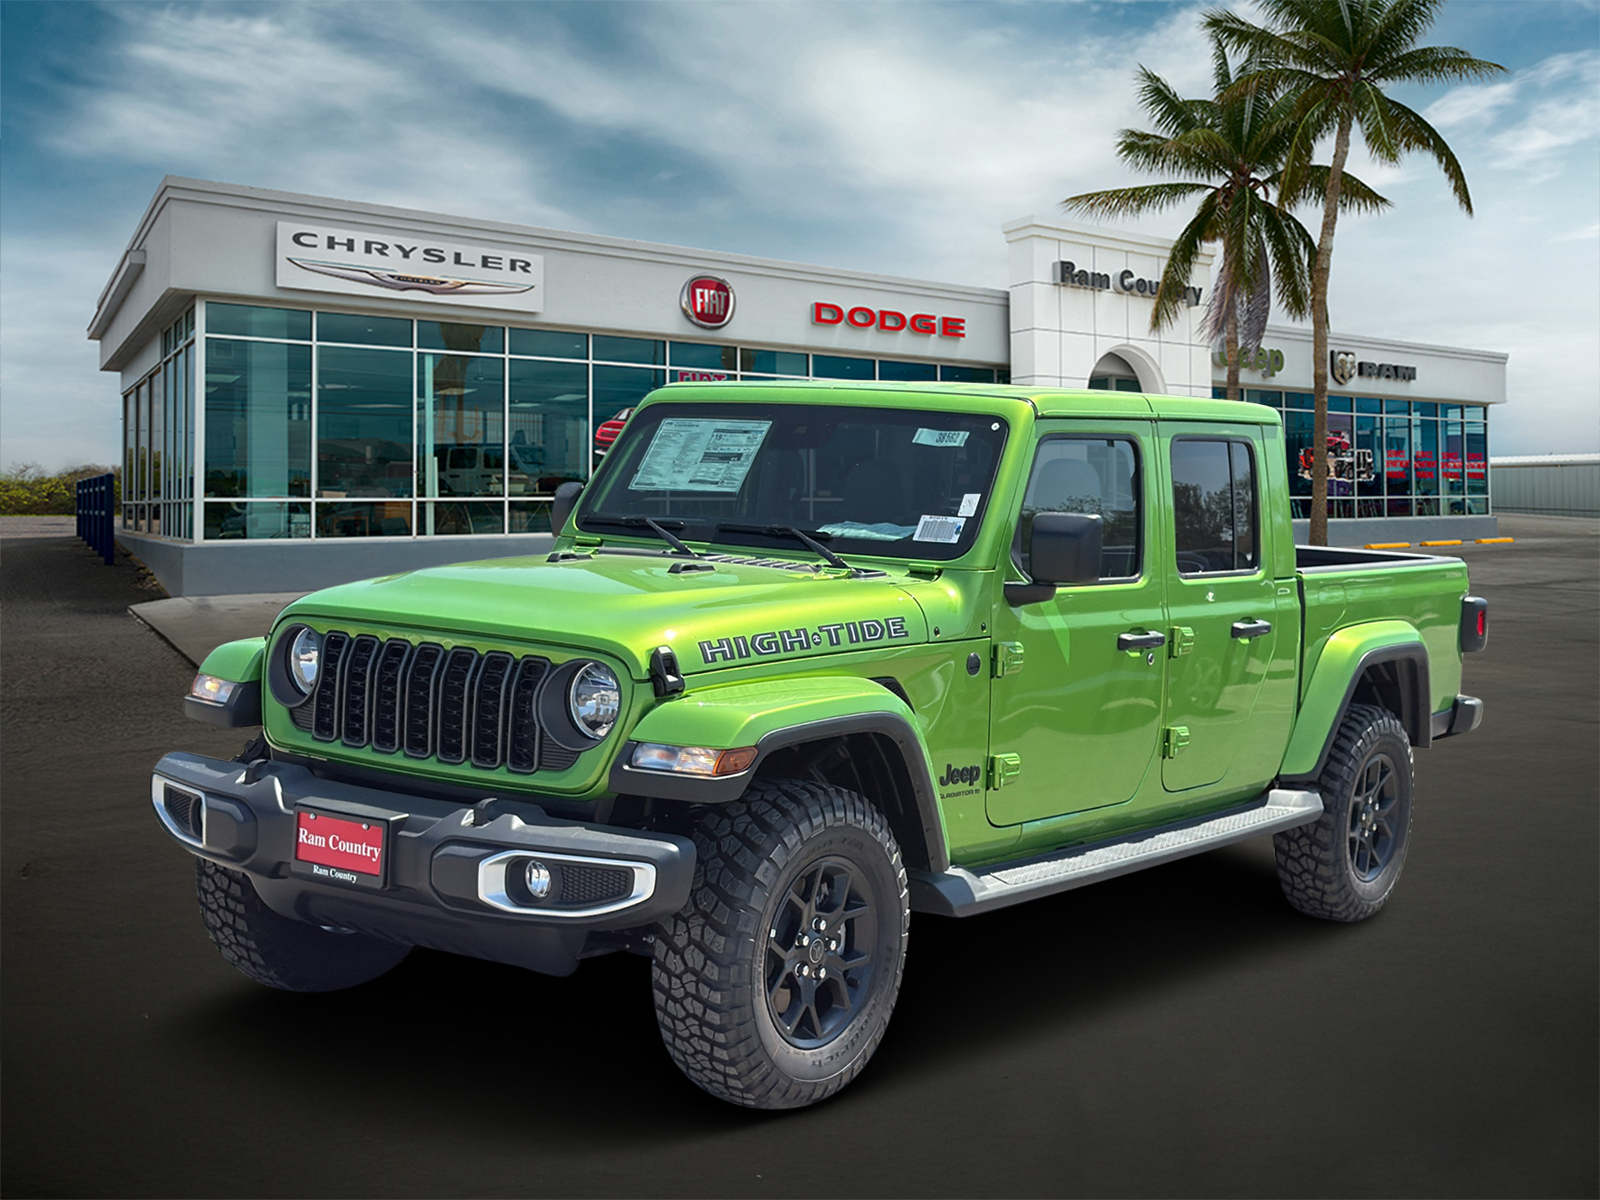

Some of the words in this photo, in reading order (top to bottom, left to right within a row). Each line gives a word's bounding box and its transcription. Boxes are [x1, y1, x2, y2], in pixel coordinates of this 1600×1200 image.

[292, 232, 532, 274] CHRYSLER
[1056, 260, 1110, 290] Ram
[1116, 269, 1203, 306] Coury
[695, 288, 727, 316] FIAT
[813, 302, 966, 338] DODGE
[1359, 362, 1416, 380] RAM
[698, 628, 811, 664] HIGH
[818, 617, 908, 647] TIDE
[939, 764, 981, 787] Jeep
[299, 827, 326, 848] Ram
[328, 834, 381, 862] Country
[313, 865, 328, 876] Ram
[329, 869, 357, 884] Country
